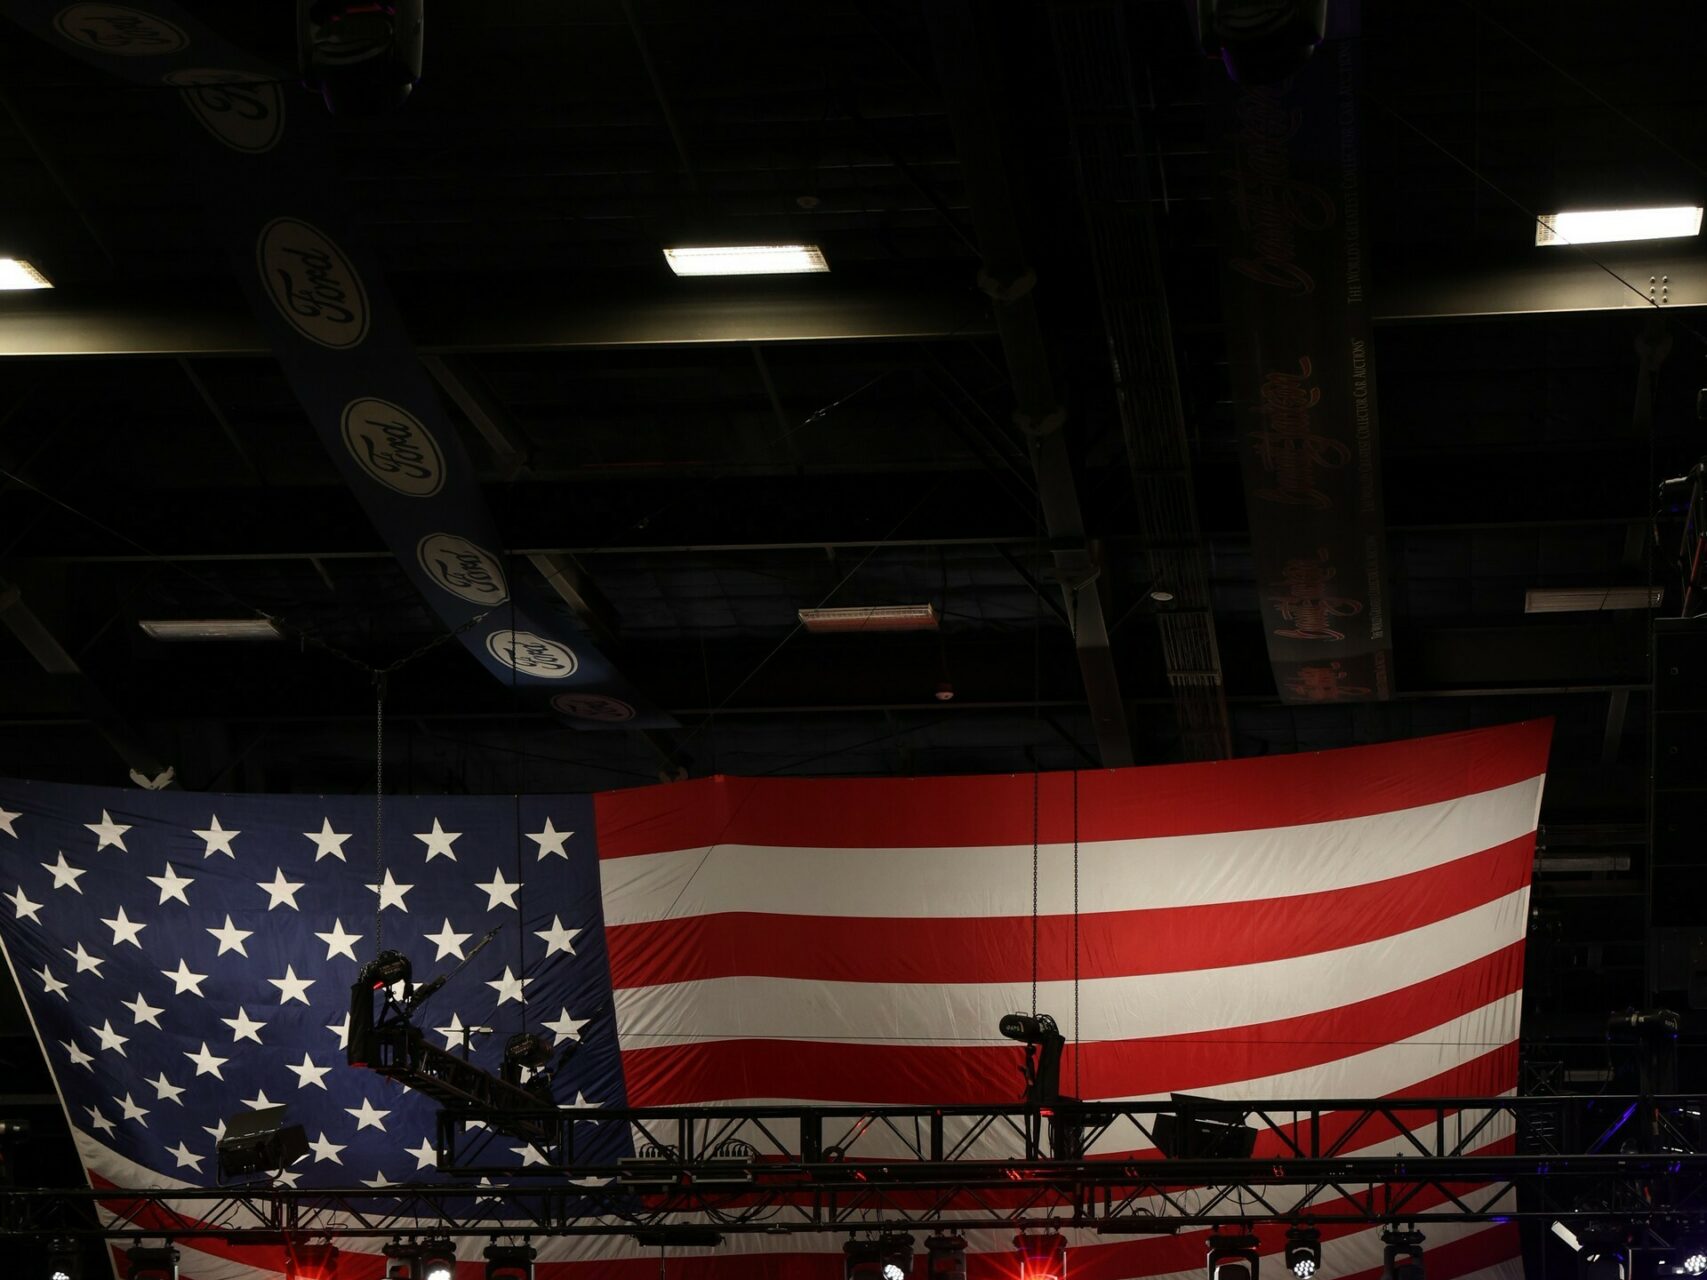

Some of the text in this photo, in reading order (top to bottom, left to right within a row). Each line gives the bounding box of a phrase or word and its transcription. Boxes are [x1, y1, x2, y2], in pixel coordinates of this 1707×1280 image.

[278, 247, 353, 323] Ford
[361, 420, 431, 479] Ford
[435, 549, 499, 593] Ford
